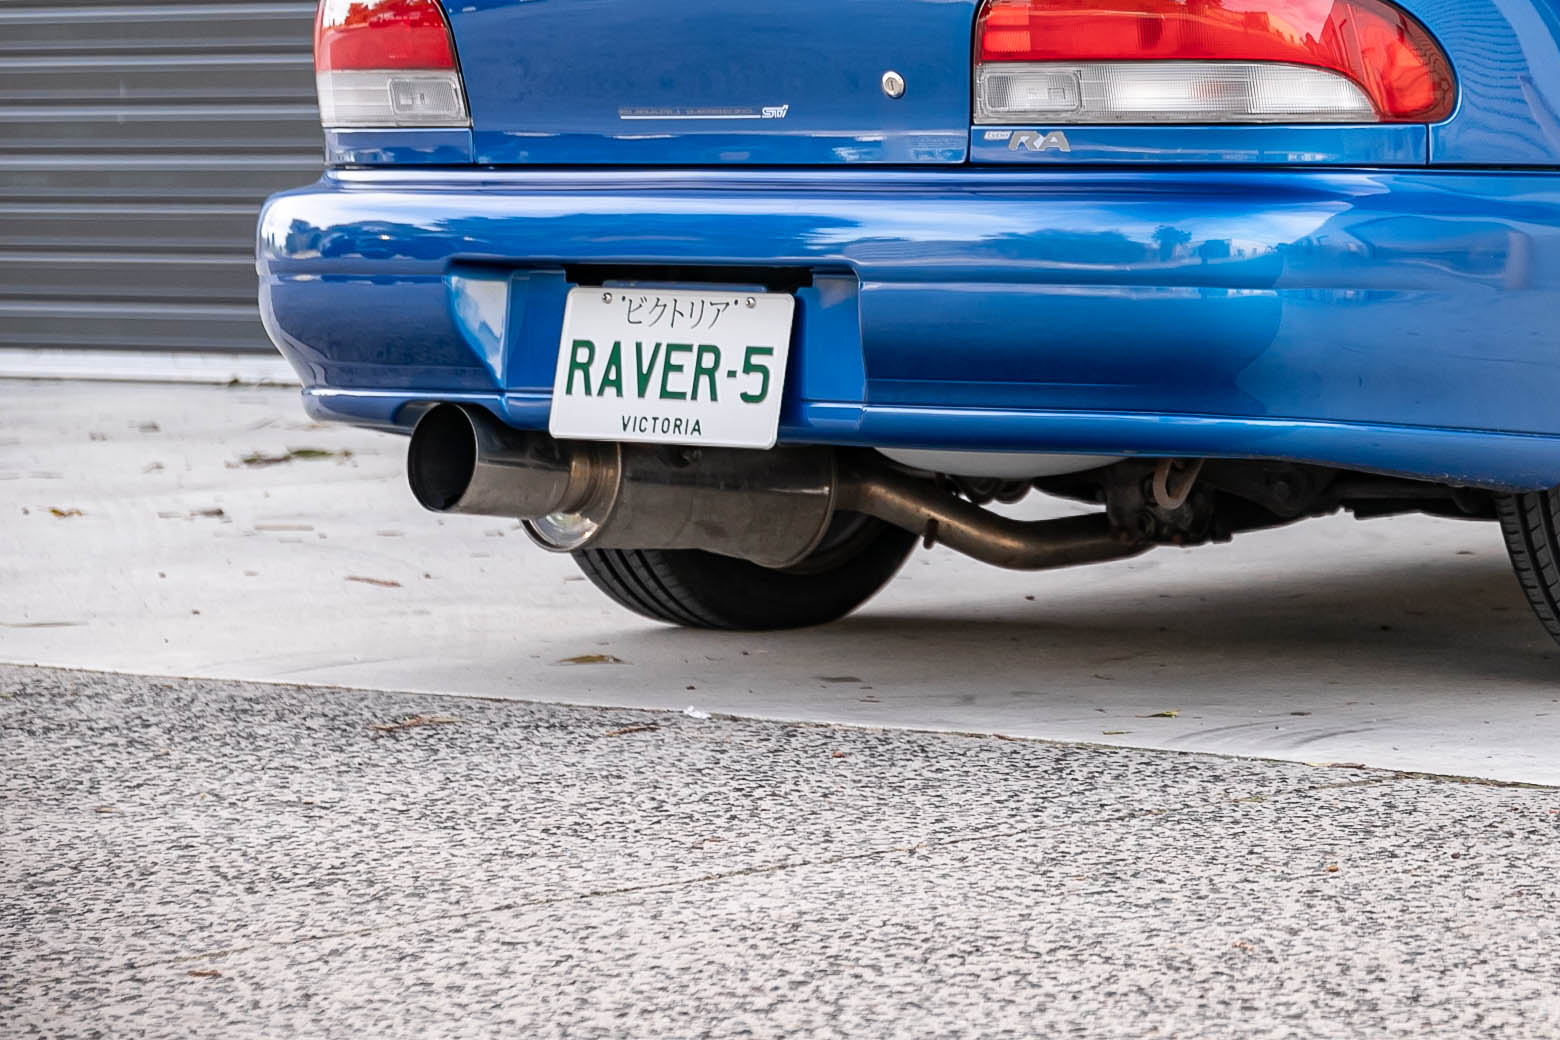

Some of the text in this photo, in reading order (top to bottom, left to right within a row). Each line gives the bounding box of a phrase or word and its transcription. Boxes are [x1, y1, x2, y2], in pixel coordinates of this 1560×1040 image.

[1008, 130, 1071, 152] RA
[626, 296, 730, 329] ビクトリア
[565, 338, 775, 404] RAVER-5
[620, 415, 702, 437] VICTORIA
